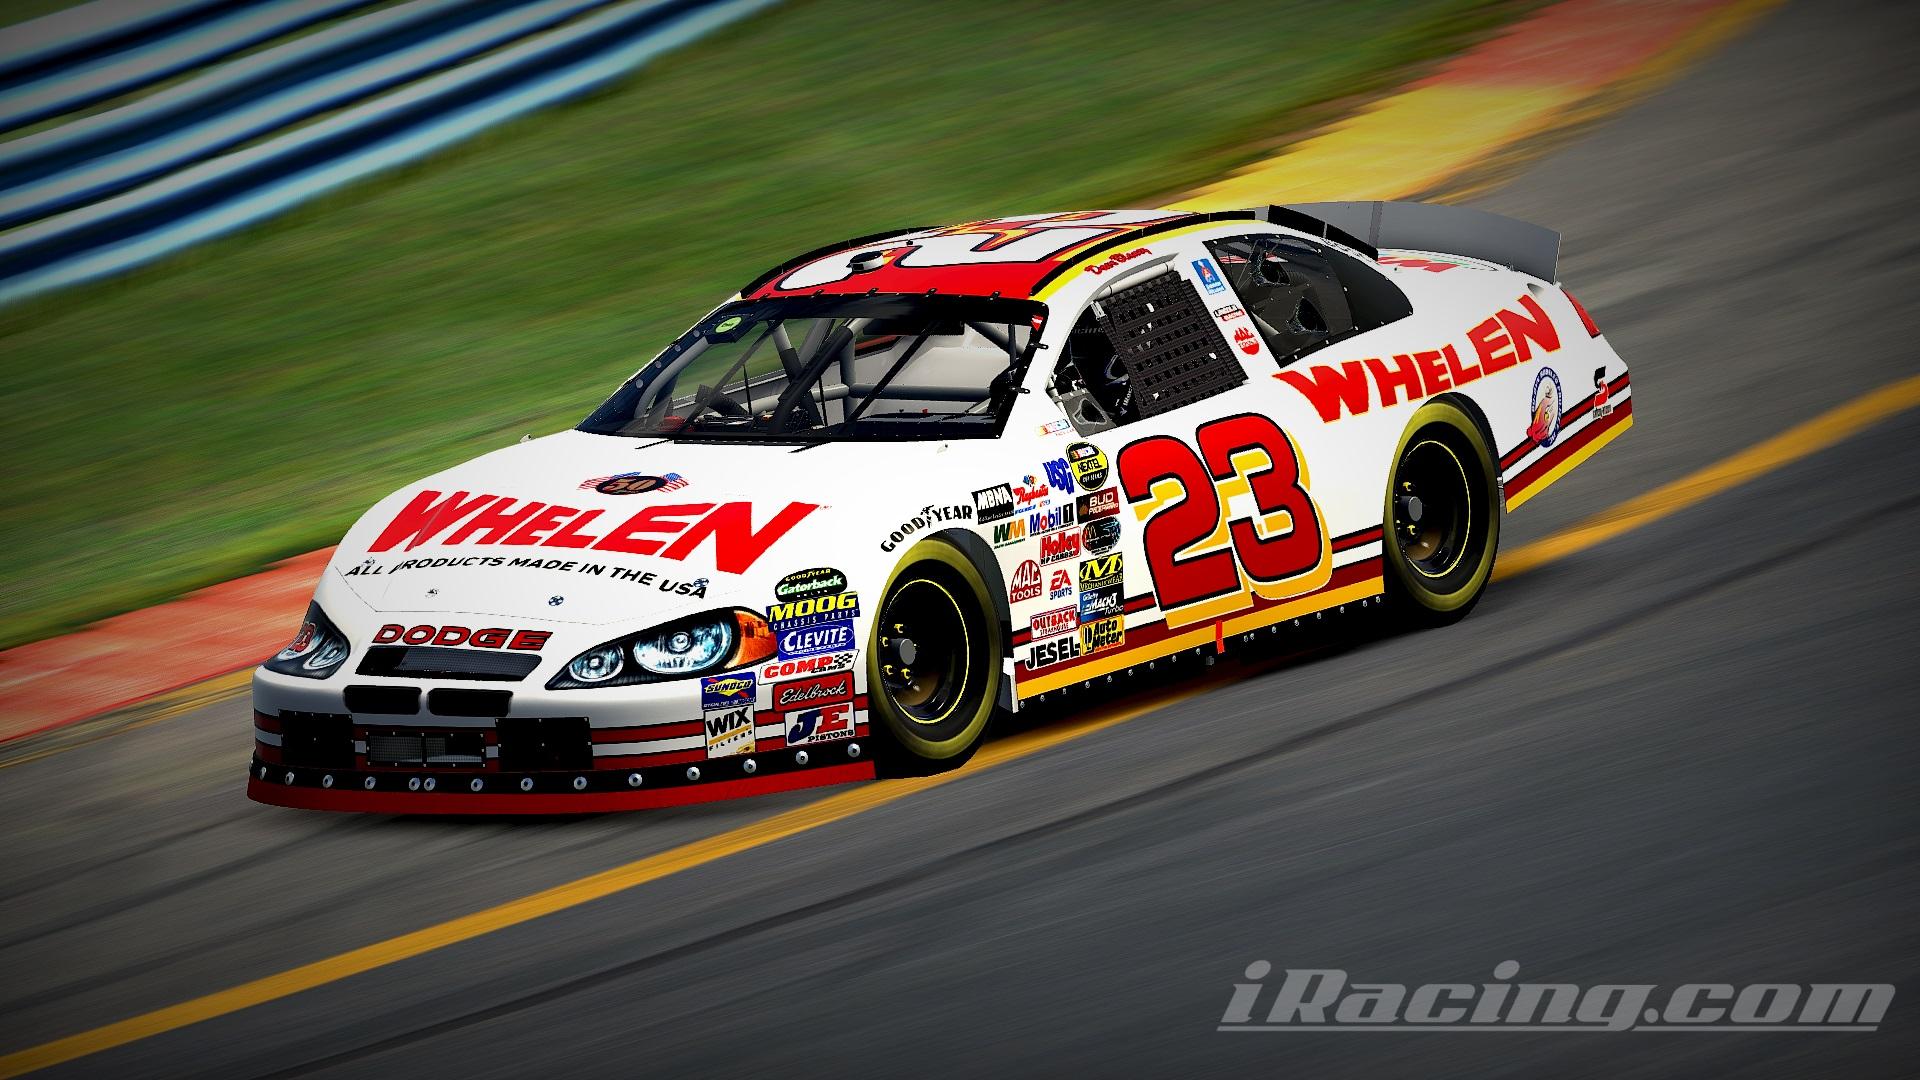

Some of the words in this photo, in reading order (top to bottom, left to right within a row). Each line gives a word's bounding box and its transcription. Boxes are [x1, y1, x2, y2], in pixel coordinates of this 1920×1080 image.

[1272, 294, 1561, 423] WHELEN
[977, 485, 1013, 511] MBNA
[1089, 492, 1114, 507] BUD
[880, 504, 973, 553] GOODYEAR
[1030, 506, 1061, 533] Mobil
[1063, 503, 1074, 524] 1
[1116, 412, 1332, 622] 23
[367, 490, 820, 575] WHELEN
[344, 566, 384, 577] ALL
[507, 557, 578, 572] MADE
[578, 563, 606, 576] IN
[609, 567, 658, 586] THE
[659, 579, 708, 599] USA
[777, 575, 843, 596] Gatorback
[1012, 561, 1041, 591] MAC
[1050, 568, 1072, 591] EA
[769, 591, 858, 622] MOOG
[1011, 586, 1041, 601] TOOLS
[1050, 587, 1073, 601] SPORTS
[773, 615, 817, 631] CHASSIS
[825, 610, 856, 620] PARTS
[1033, 608, 1075, 630] OUTBACK
[371, 623, 553, 651] DODGE
[783, 626, 848, 652] CLEVITE
[1025, 636, 1080, 670] JESEL
[764, 655, 833, 679] COMP
[706, 679, 753, 693] SUNOCO
[780, 680, 847, 705] Edelbrock
[706, 707, 751, 737] WIX
[788, 704, 850, 743] JE
[807, 729, 855, 743] PISTONS
